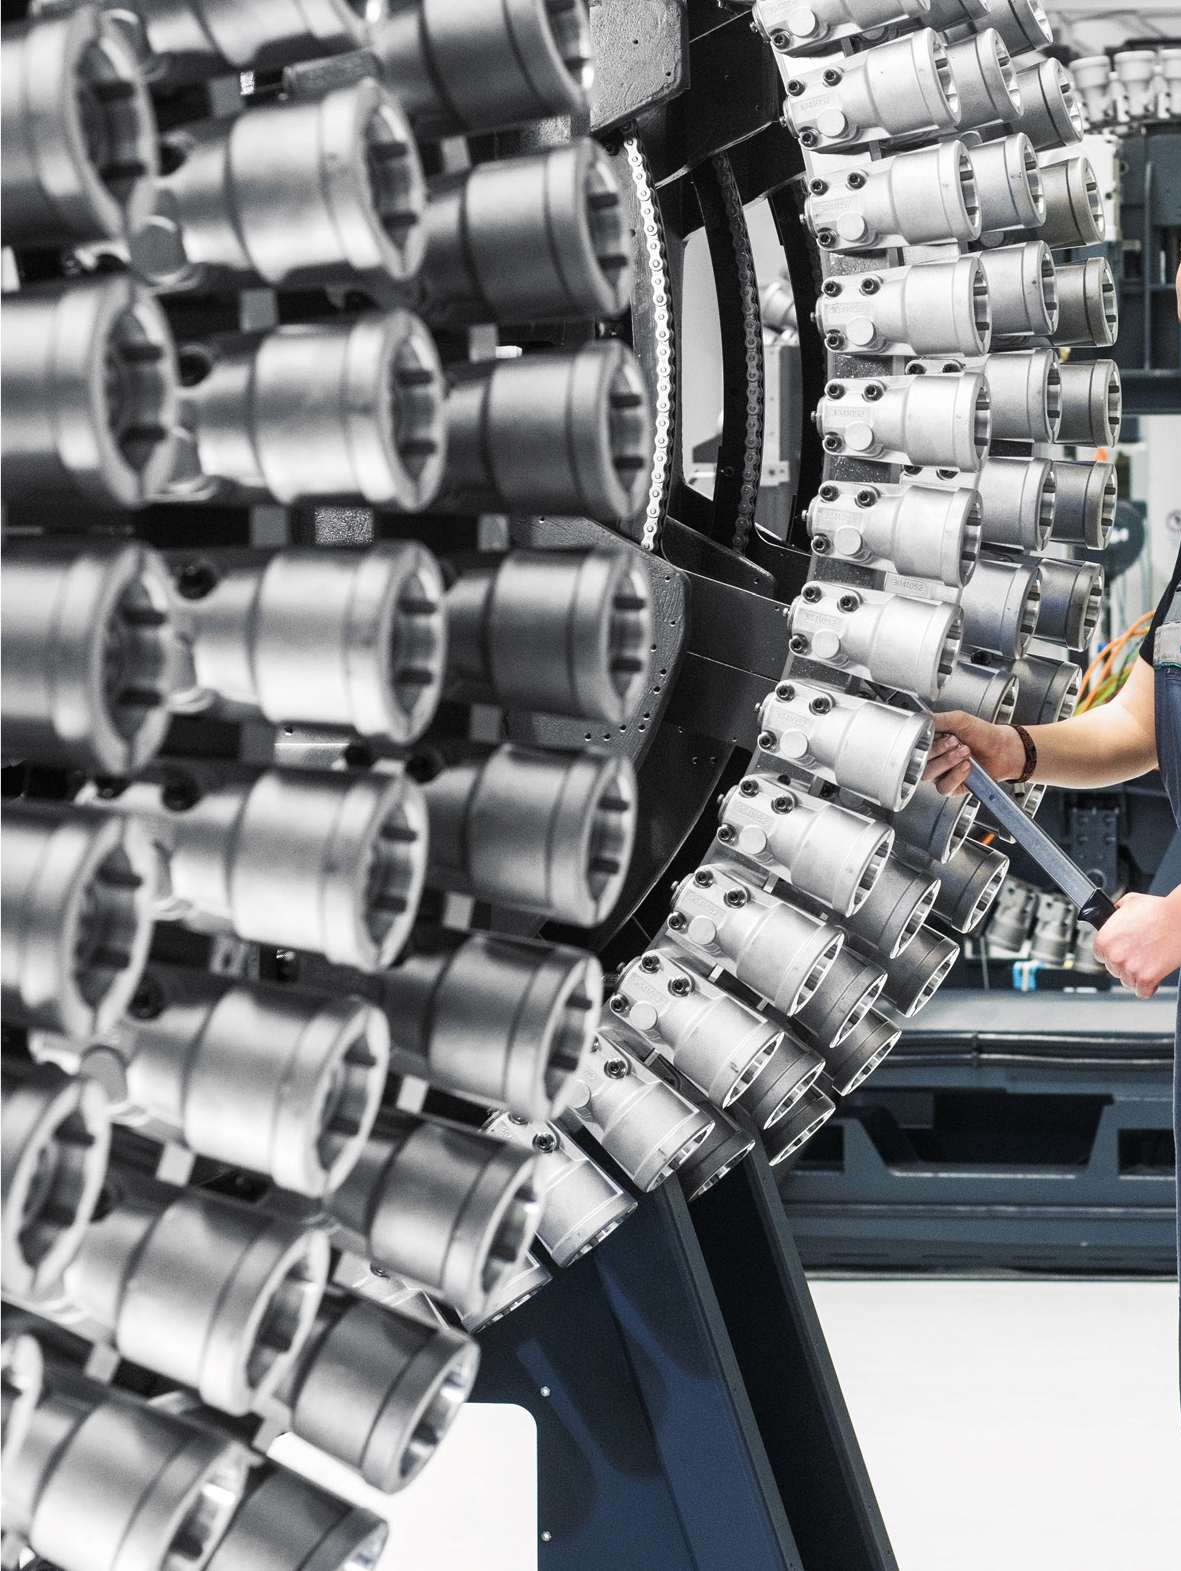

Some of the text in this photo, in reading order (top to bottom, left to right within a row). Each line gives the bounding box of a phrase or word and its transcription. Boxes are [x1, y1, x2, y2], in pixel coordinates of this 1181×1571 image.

[799, 97, 831, 111] 3041052
[831, 408, 865, 418] 3041052
[891, 578, 925, 592] 3041052
[803, 611, 836, 627] 3041052
